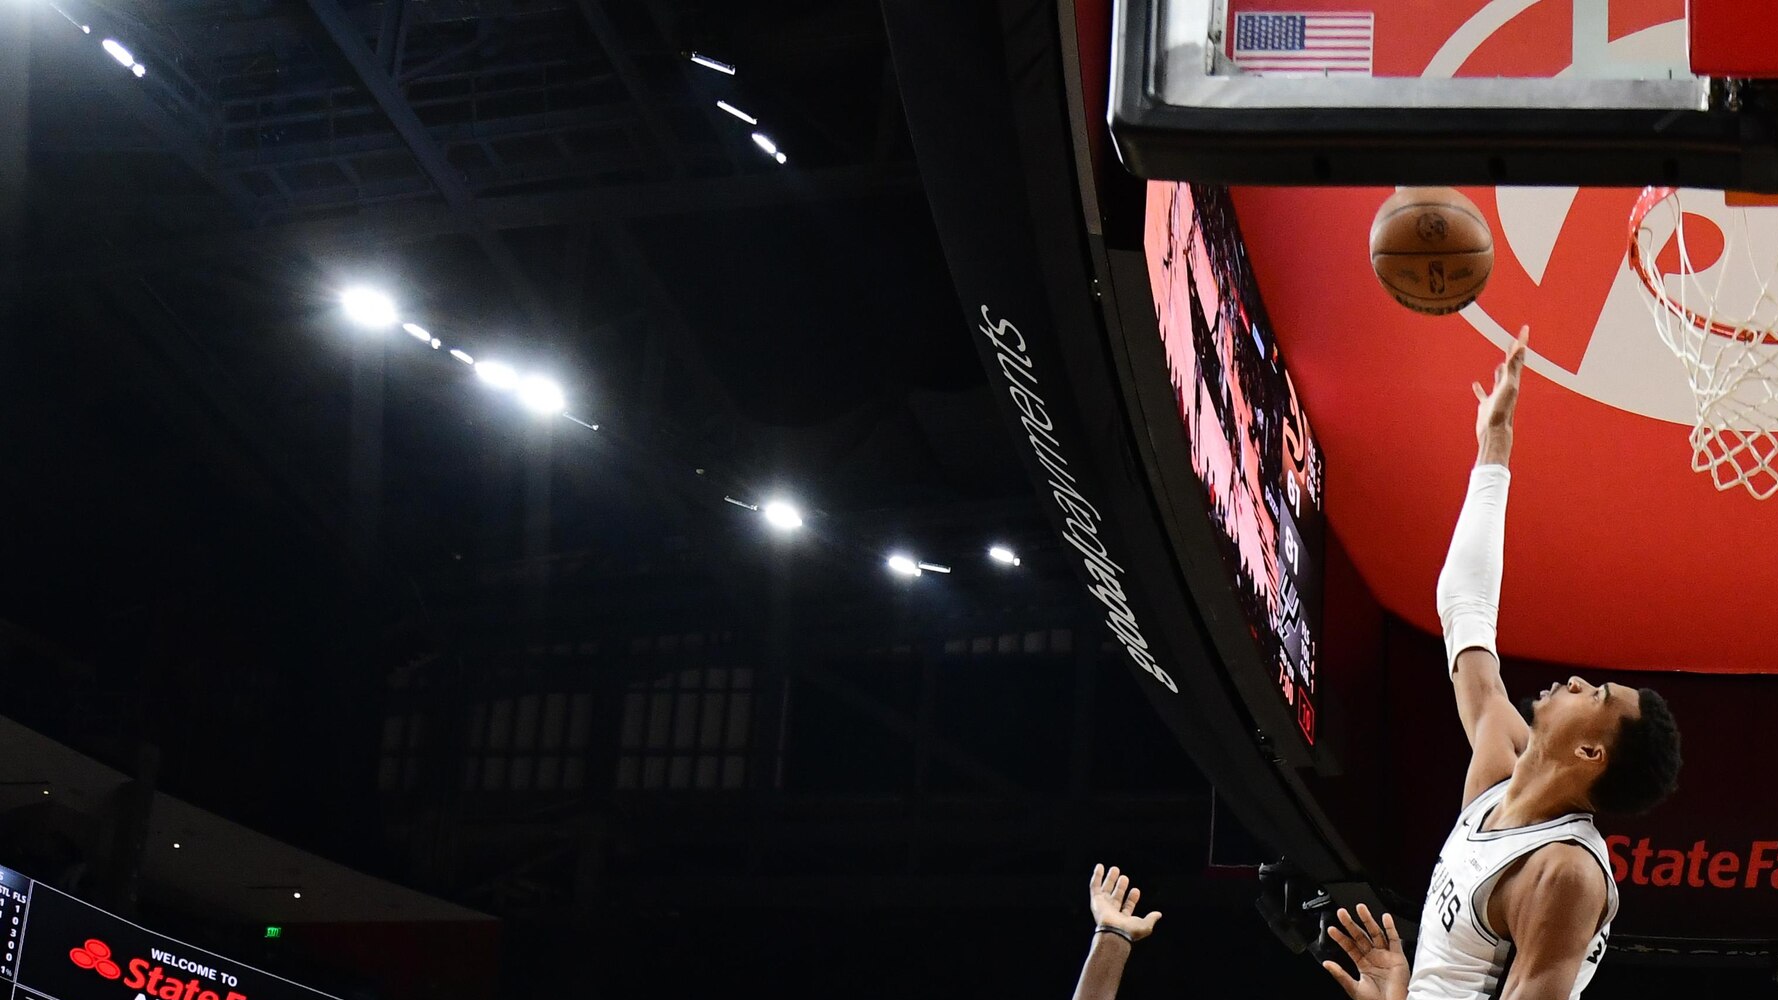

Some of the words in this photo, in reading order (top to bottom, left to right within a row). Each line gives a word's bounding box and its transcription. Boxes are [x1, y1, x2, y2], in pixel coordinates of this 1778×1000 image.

[1287, 469, 1300, 518] 61
[1285, 525, 1298, 575] 81
[12, 891, 26, 903] FLS
[151, 948, 217, 980] WELCOME
[220, 973, 238, 987] TO
